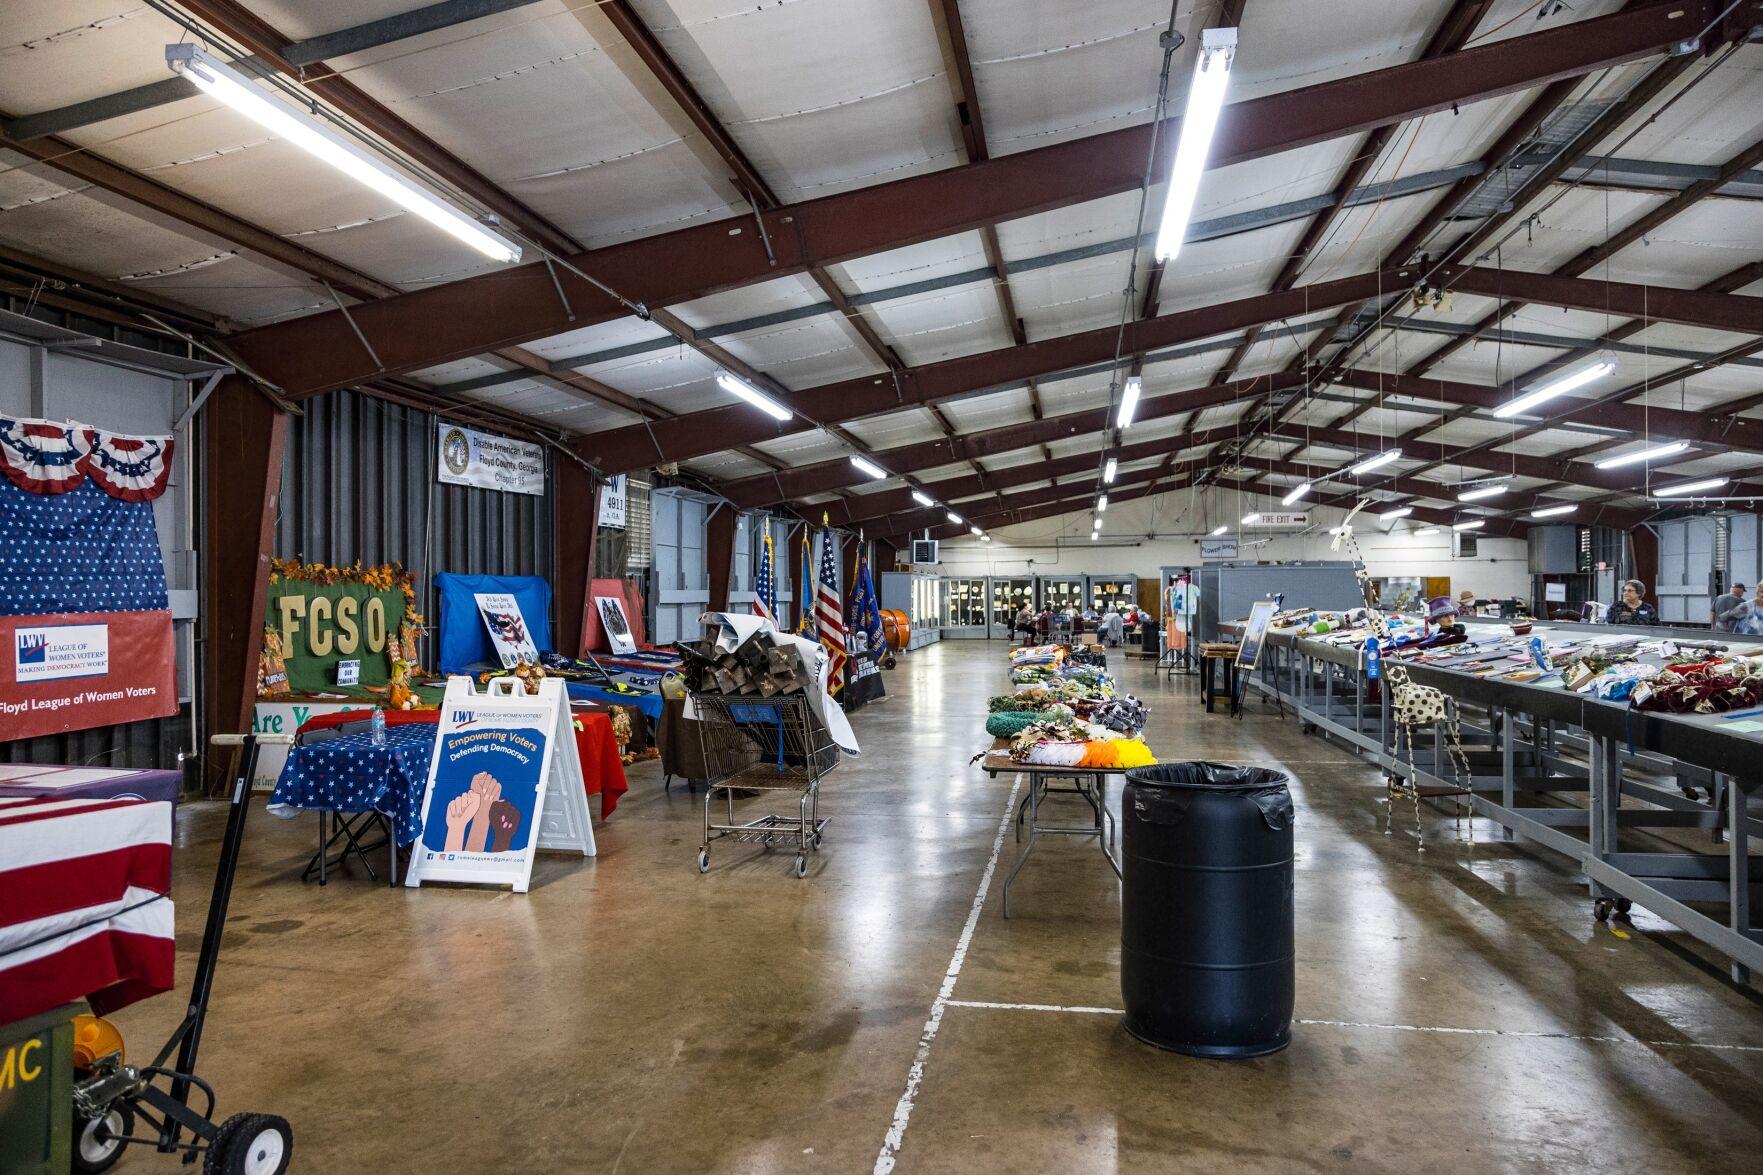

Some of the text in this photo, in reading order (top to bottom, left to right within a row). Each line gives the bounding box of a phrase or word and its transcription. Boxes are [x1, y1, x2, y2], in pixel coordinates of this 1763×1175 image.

[473, 437, 542, 460] Disable American Veterans
[479, 454, 495, 467] Floyd
[518, 461, 538, 475] Georgia
[494, 472, 525, 486] Chapter 95
[607, 496, 623, 510] 4911
[1262, 515, 1290, 524] FIRE EXIT
[1201, 546, 1221, 554] FLOWER
[277, 595, 386, 660] FCSO
[20, 634, 45, 648] LWV
[49, 653, 76, 662] WOMEN
[47, 662, 86, 671] DEMOCRACY
[31, 698, 71, 710] League
[73, 693, 84, 705] of
[86, 691, 124, 702] Women
[126, 686, 156, 697] Voters
[452, 710, 475, 722] LWV
[447, 730, 538, 752] Empowering Voters
[449, 743, 530, 765] Defending Democracy
